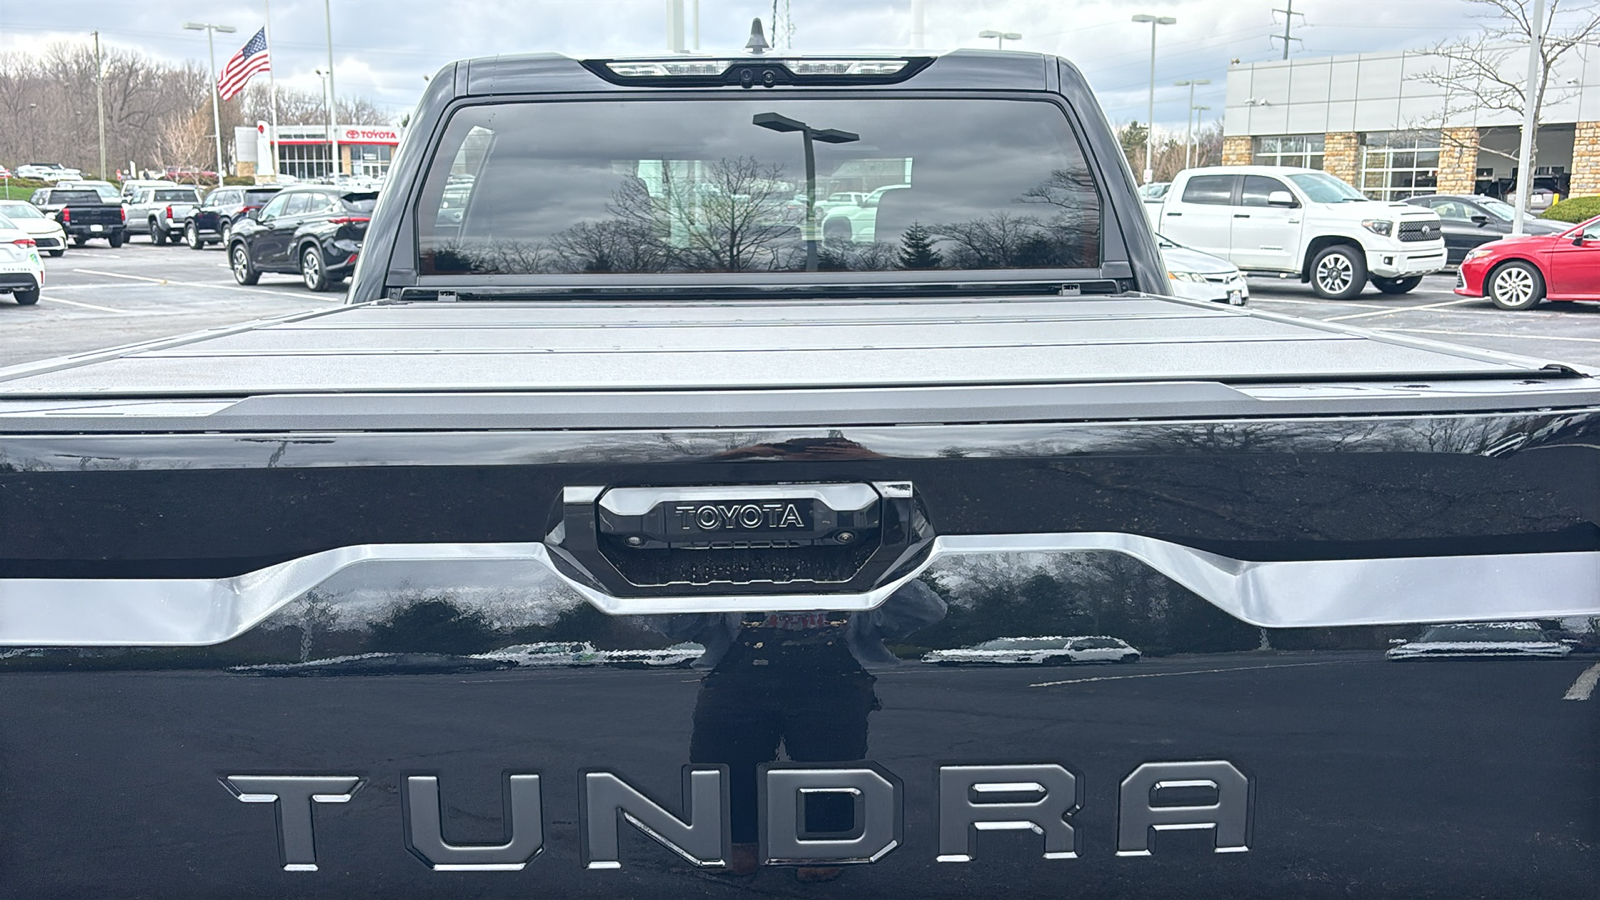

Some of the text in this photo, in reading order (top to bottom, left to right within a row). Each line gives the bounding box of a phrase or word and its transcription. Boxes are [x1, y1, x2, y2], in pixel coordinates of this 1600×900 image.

[360, 130, 397, 139] TOYOTA
[675, 503, 805, 530] TOYOTA
[217, 759, 1253, 872] TUNDRA
